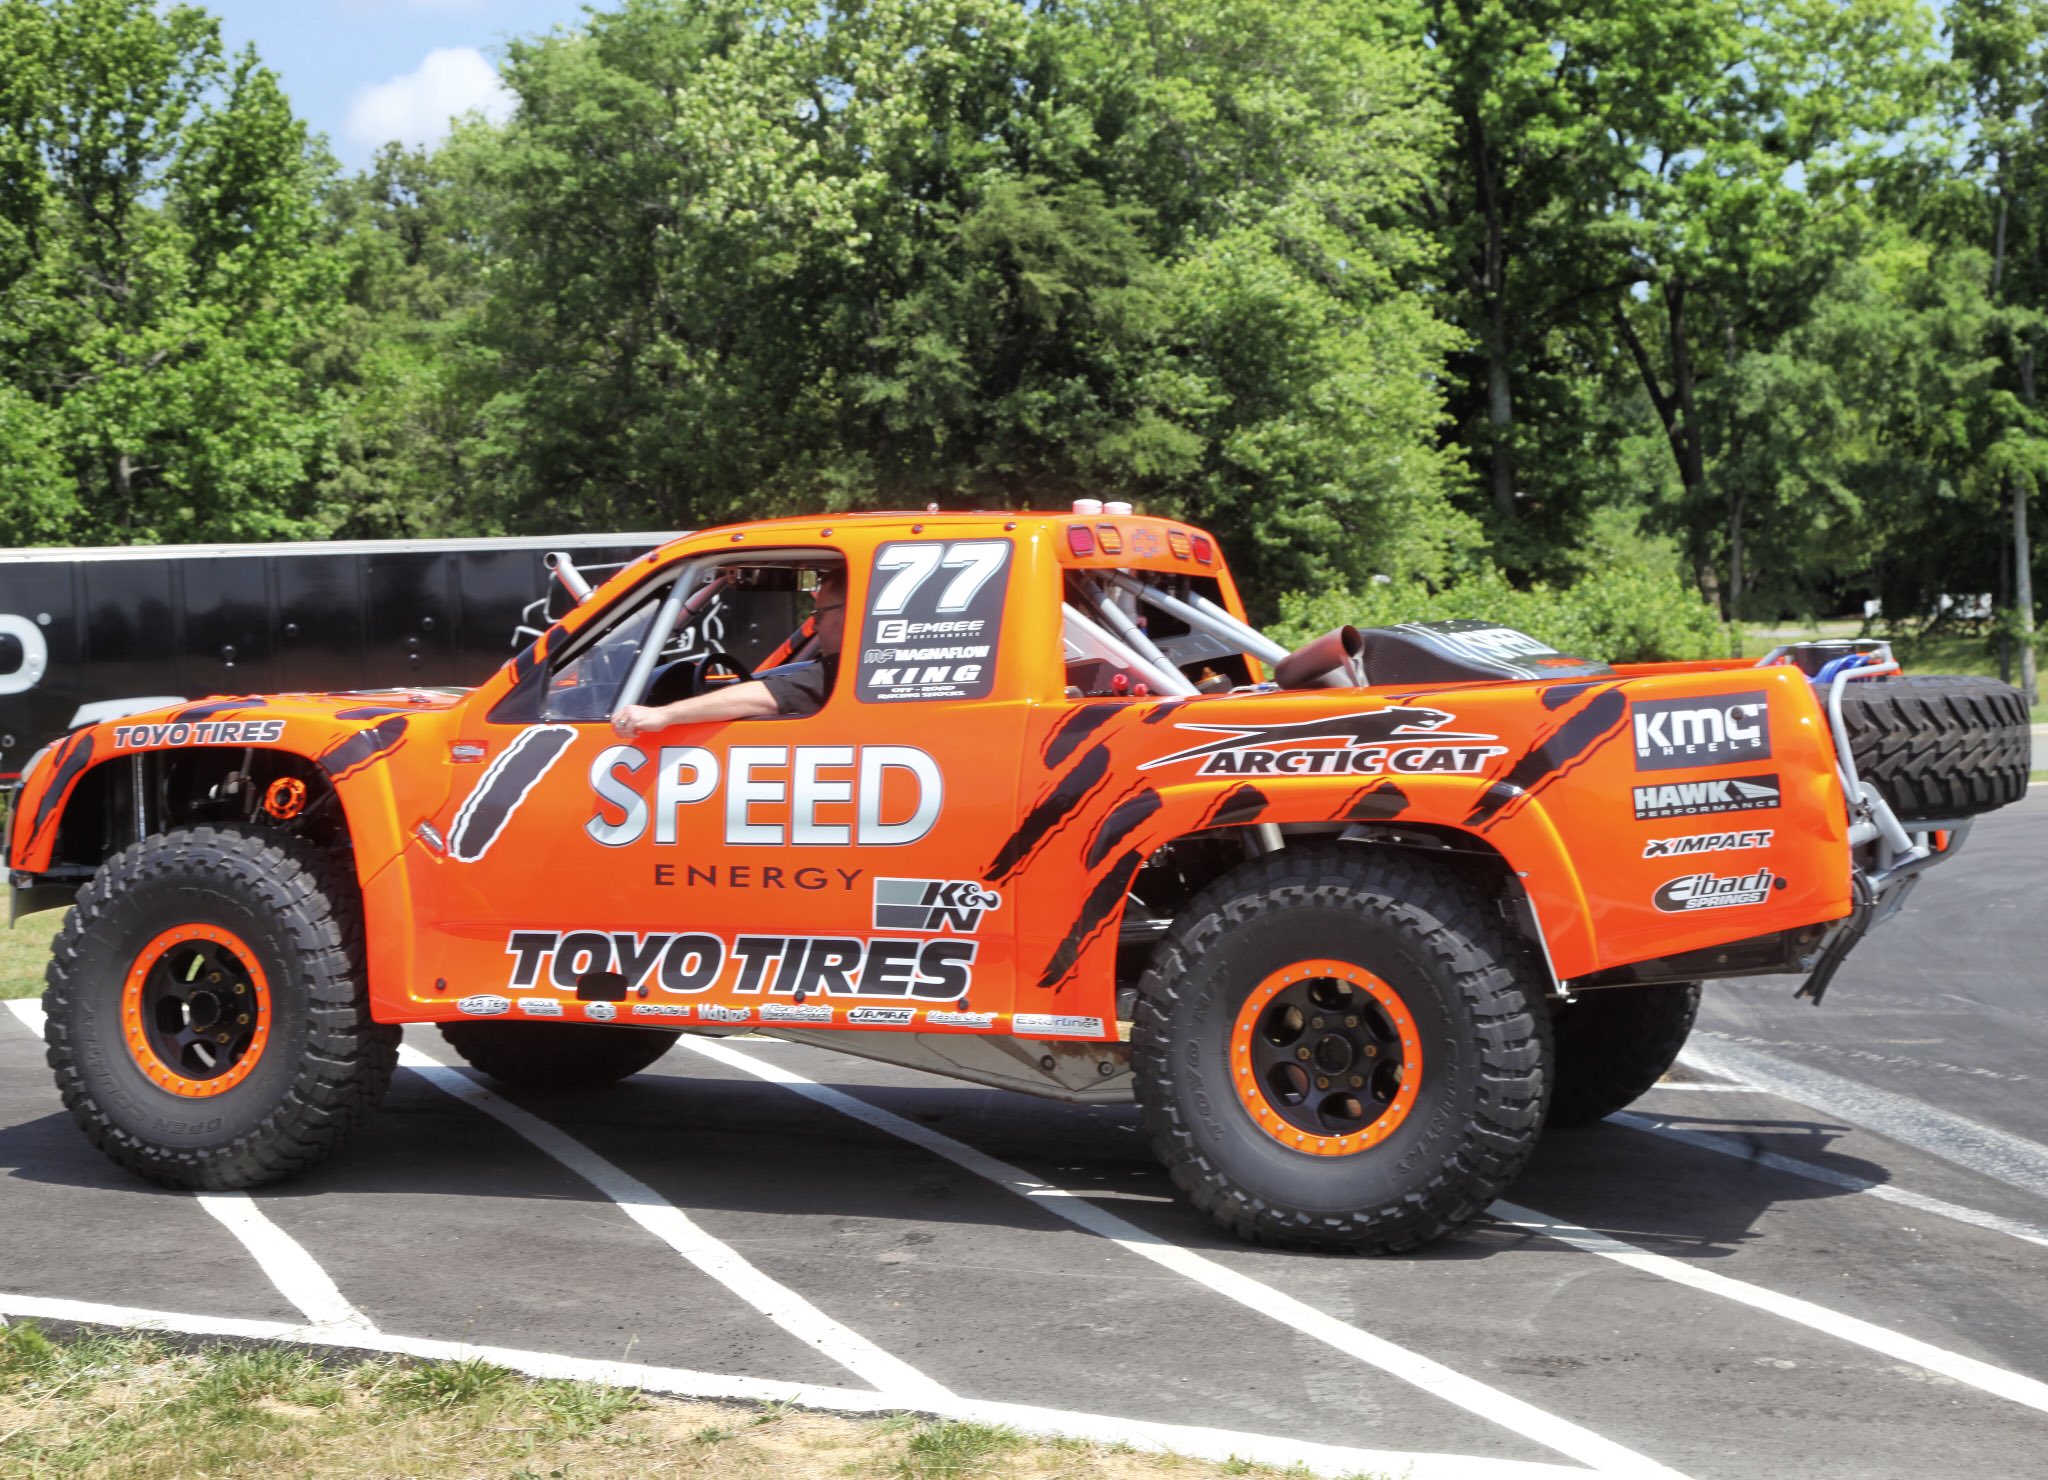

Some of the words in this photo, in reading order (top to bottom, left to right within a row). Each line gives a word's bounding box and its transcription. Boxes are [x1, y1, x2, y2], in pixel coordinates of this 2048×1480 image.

[872, 541, 1009, 615] 77
[907, 620, 985, 633] EMBEE
[895, 645, 990, 661] MAGNAFLOW
[868, 664, 982, 685] KING
[113, 723, 191, 748] TOYO
[193, 720, 287, 744] TIRES
[1638, 737, 1761, 757] WHEELS
[1198, 748, 1387, 775] ARCTIC
[1390, 747, 1492, 774] CAT
[584, 744, 944, 848] SPEED
[1633, 780, 1734, 810] HAWK
[1635, 800, 1779, 819] PERFORMANCE
[654, 864, 864, 891] ENERGY
[1660, 867, 1774, 901] Eibach
[1685, 892, 1762, 910] SPRINGS
[507, 930, 726, 995] TOYO
[731, 935, 980, 1001] TIRES
[849, 1007, 911, 1020] JAMAR
